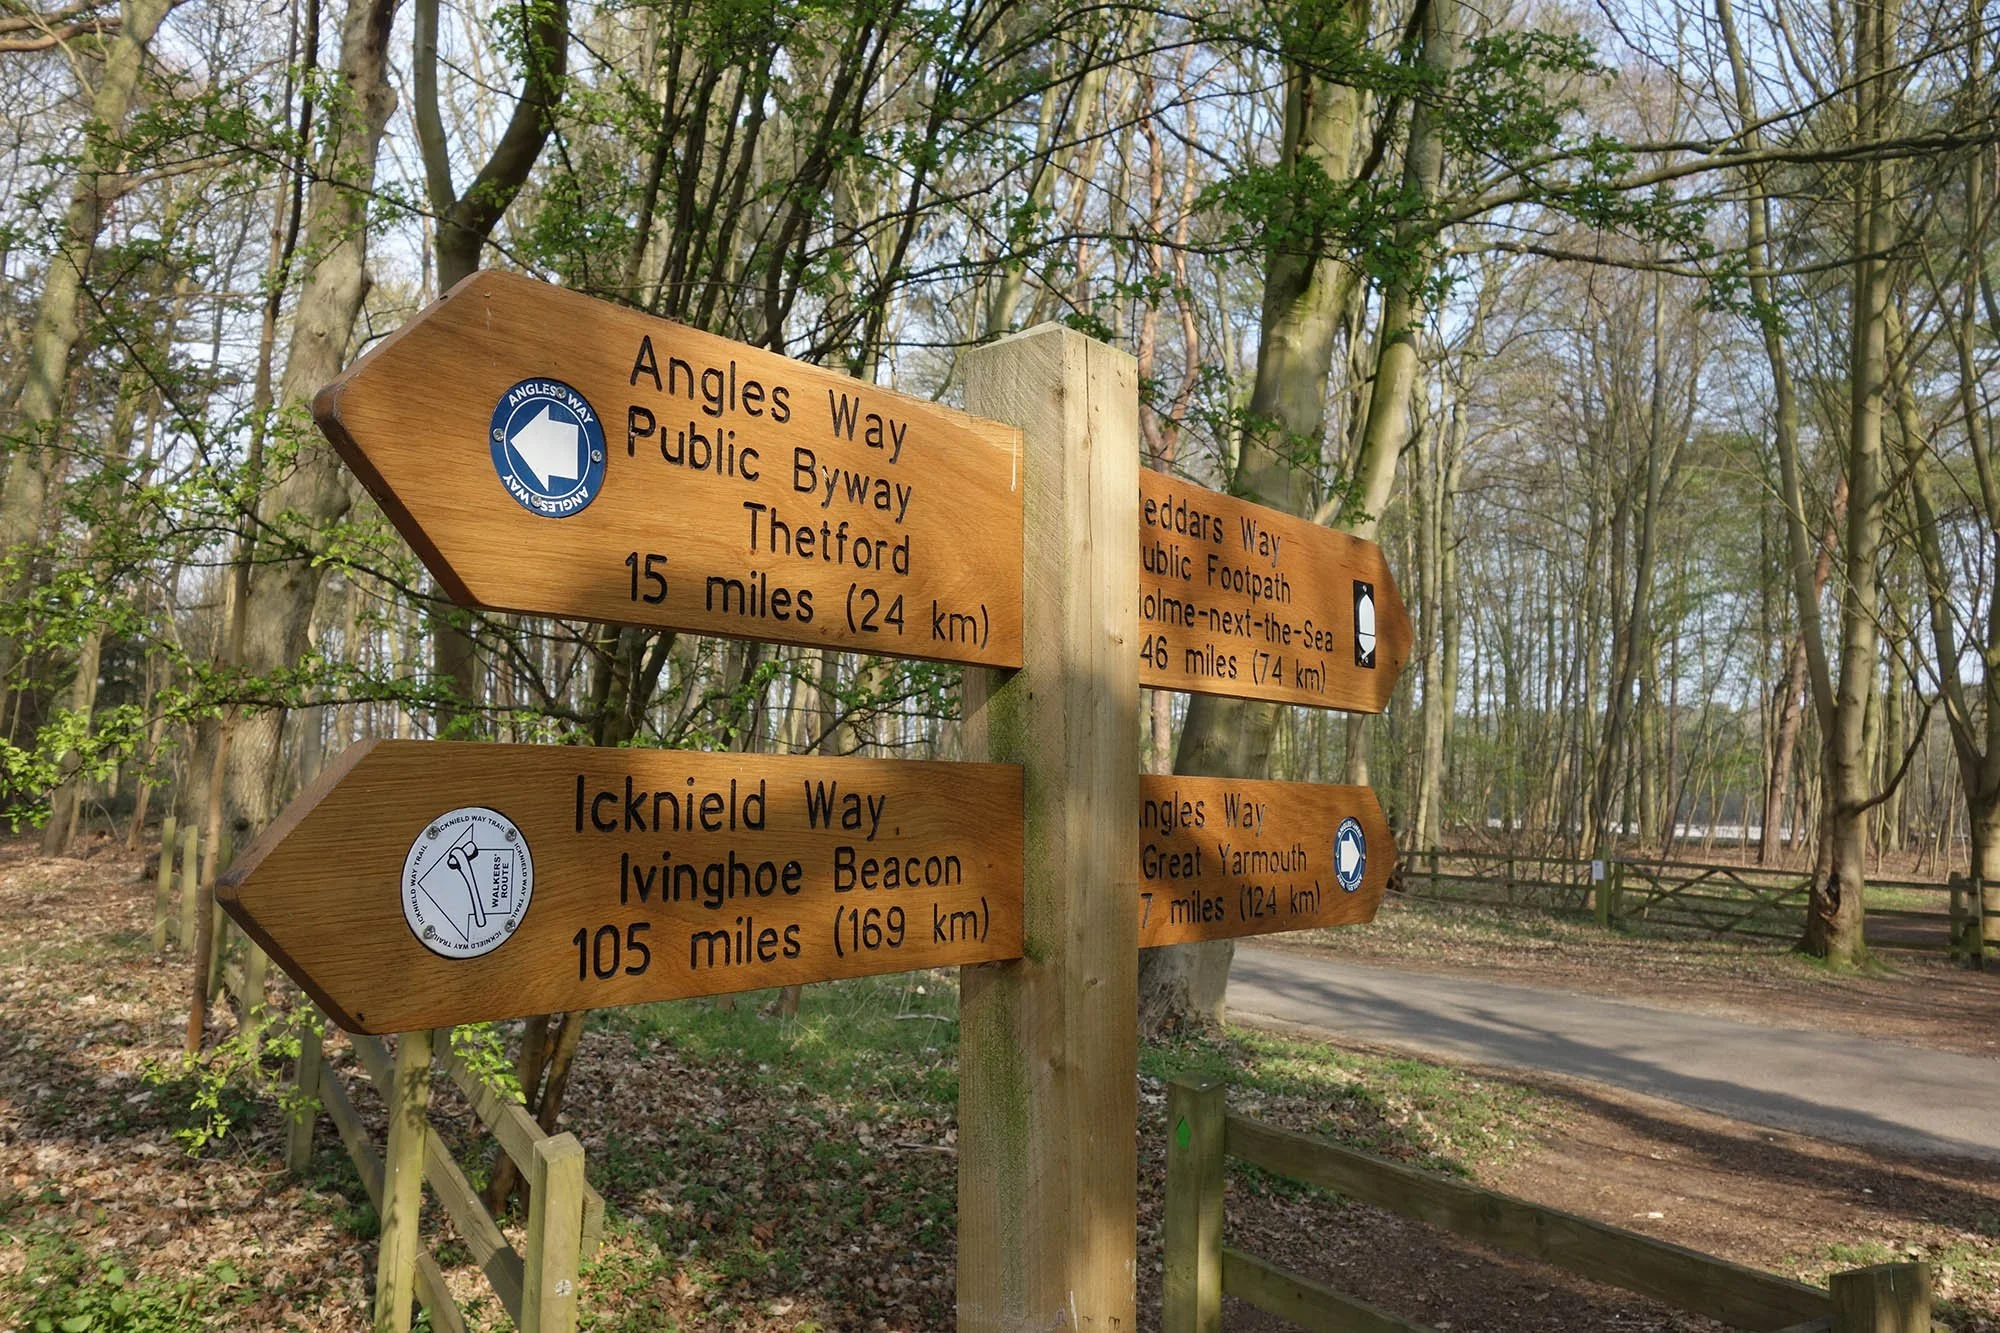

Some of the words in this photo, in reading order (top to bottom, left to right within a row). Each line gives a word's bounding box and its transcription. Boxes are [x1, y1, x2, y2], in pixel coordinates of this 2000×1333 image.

[508, 383, 557, 407] ANGLES
[567, 393, 594, 425] WAY
[630, 334, 790, 424] Angles
[829, 389, 907, 464] Way
[627, 405, 760, 482] Public
[794, 447, 912, 524] Byway
[502, 474, 530, 505] WAY
[540, 486, 589, 512] ANGLES
[743, 501, 910, 576] Thetford
[1138, 487, 1223, 544] eddars
[1240, 516, 1281, 568] Way
[1139, 540, 1192, 582] ublic
[1207, 553, 1291, 604] Footpath
[624, 551, 668, 605] 15
[705, 571, 814, 623] miles
[846, 583, 904, 635] (24
[932, 600, 989, 650] km)
[1140, 633, 1168, 670] 46
[1185, 643, 1237, 680] miles
[1252, 649, 1282, 686] (74
[1295, 660, 1326, 694] km)
[438, 816, 470, 833] ICKNIELD
[488, 818, 505, 832] TRAIL
[575, 774, 766, 833] Icknield
[804, 779, 886, 842] Way
[1139, 791, 1206, 836] ngles
[1224, 792, 1265, 837] Way
[414, 845, 428, 866] TRAIL
[514, 842, 528, 877] ICKNIELD
[620, 849, 803, 910] Ivinghoe
[834, 846, 962, 893] Beacon
[1143, 844, 1201, 880] Great
[1218, 843, 1307, 876] Yarmouth
[501, 863, 509, 898] ROUTE
[1170, 889, 1225, 927] miles
[1239, 884, 1276, 922] (124
[1290, 880, 1321, 916] km)
[410, 889, 425, 926] ICKNIELD
[573, 921, 651, 982] 105
[691, 915, 801, 970] miles
[834, 904, 906, 958] (169
[932, 896, 990, 944] km)
